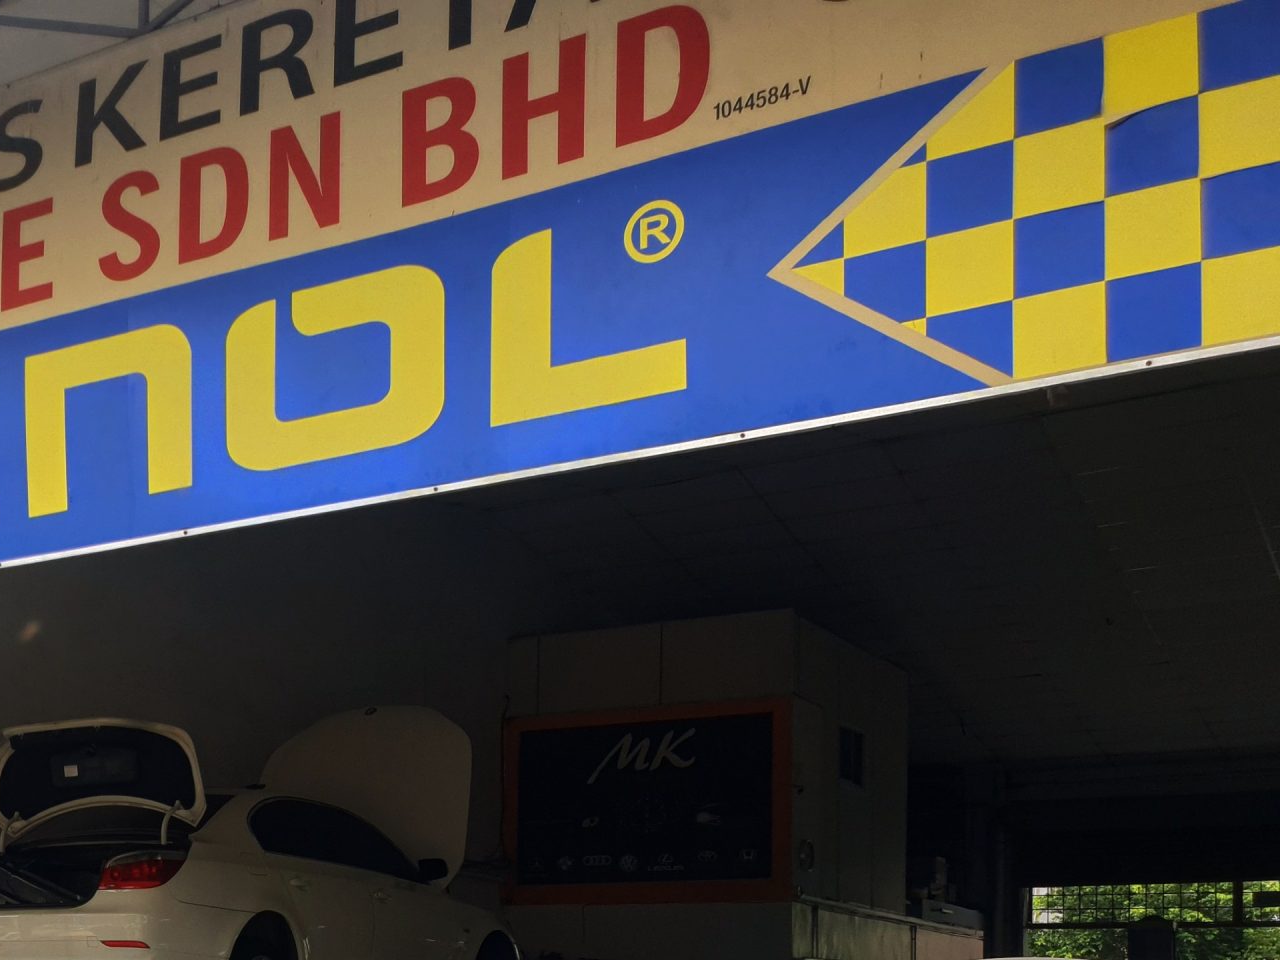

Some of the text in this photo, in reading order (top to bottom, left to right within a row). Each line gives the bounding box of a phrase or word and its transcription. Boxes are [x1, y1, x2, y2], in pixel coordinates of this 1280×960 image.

[74, 0, 600, 168] KERE
[713, 75, 812, 121] 1044584-V
[99, 111, 341, 282] SDN
[401, 5, 710, 208] BHD
[586, 727, 697, 785] MK
